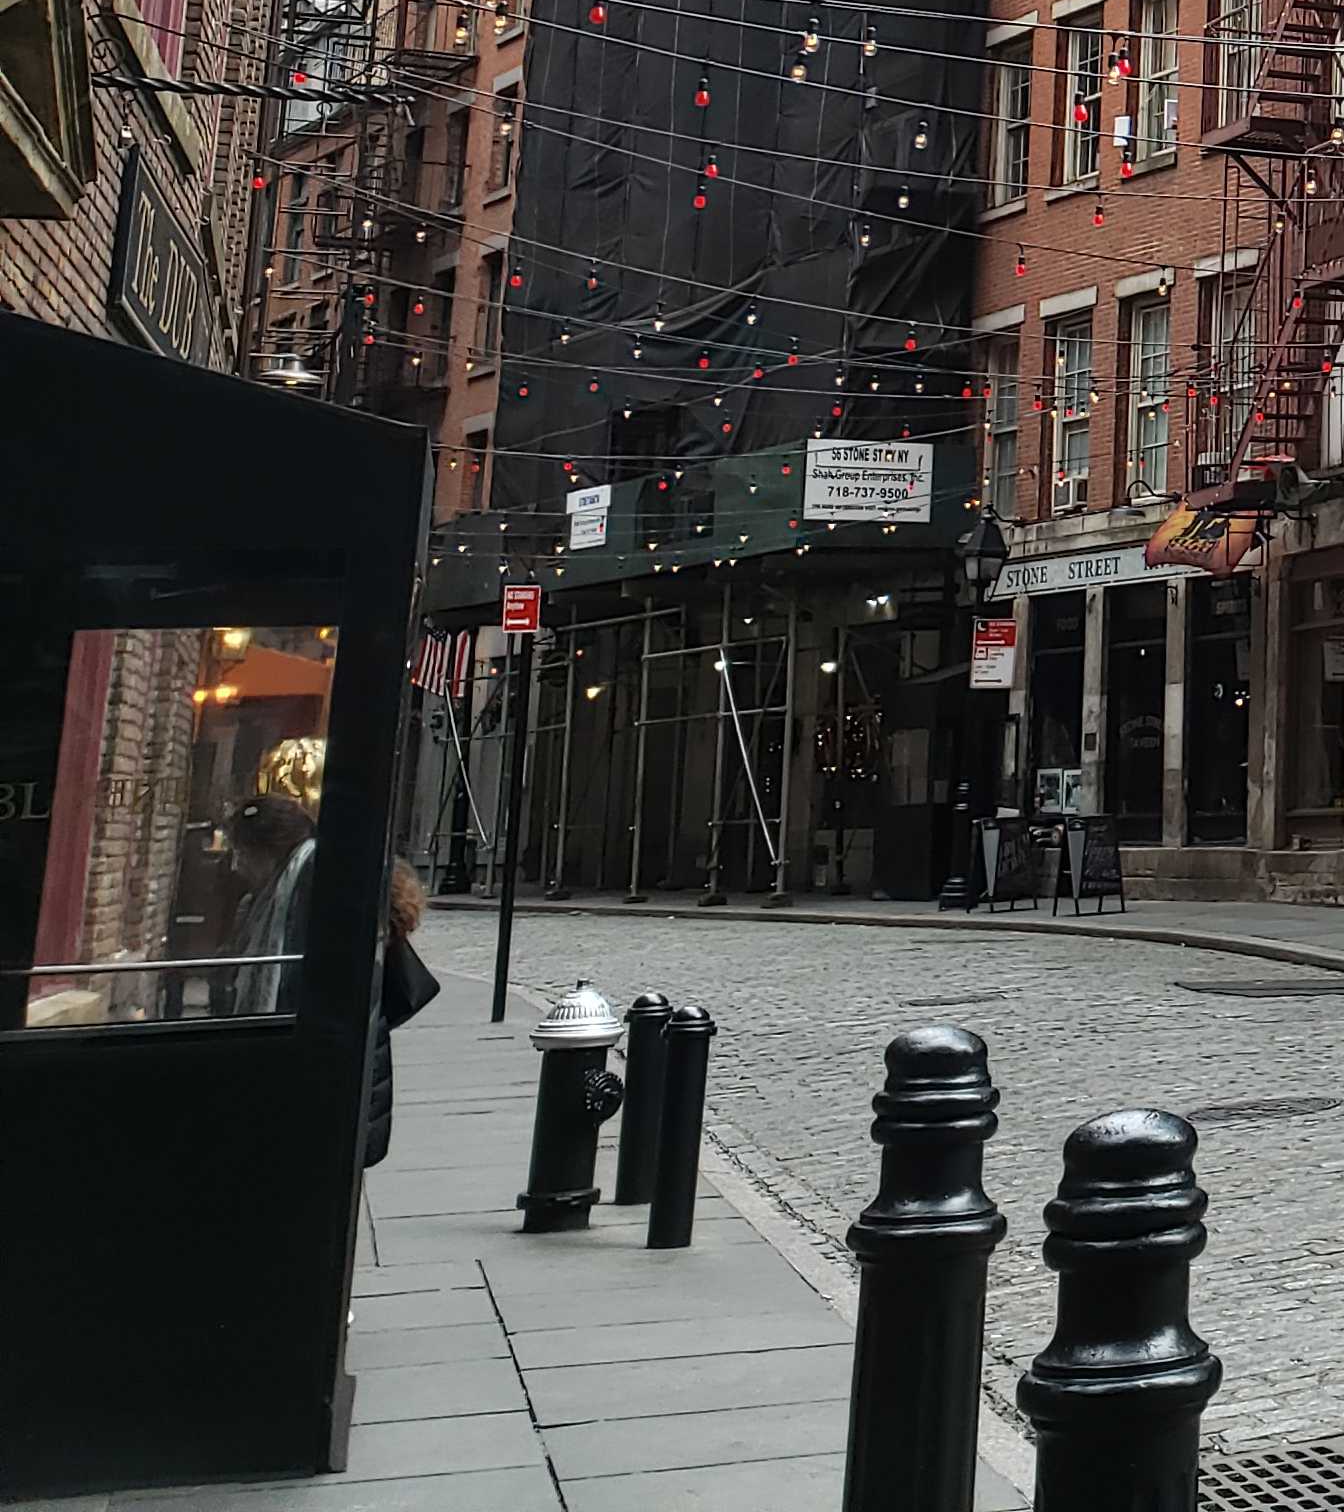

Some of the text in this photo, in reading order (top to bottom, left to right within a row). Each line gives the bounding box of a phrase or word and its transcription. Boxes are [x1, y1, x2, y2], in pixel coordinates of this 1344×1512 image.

[843, 447, 870, 462] STONE
[872, 448, 883, 463] ST
[897, 450, 909, 464] NY
[835, 469, 860, 483] Group
[826, 485, 909, 500] 718-737-9500
[1006, 565, 1049, 589] STONE
[1067, 556, 1121, 580] STREET
